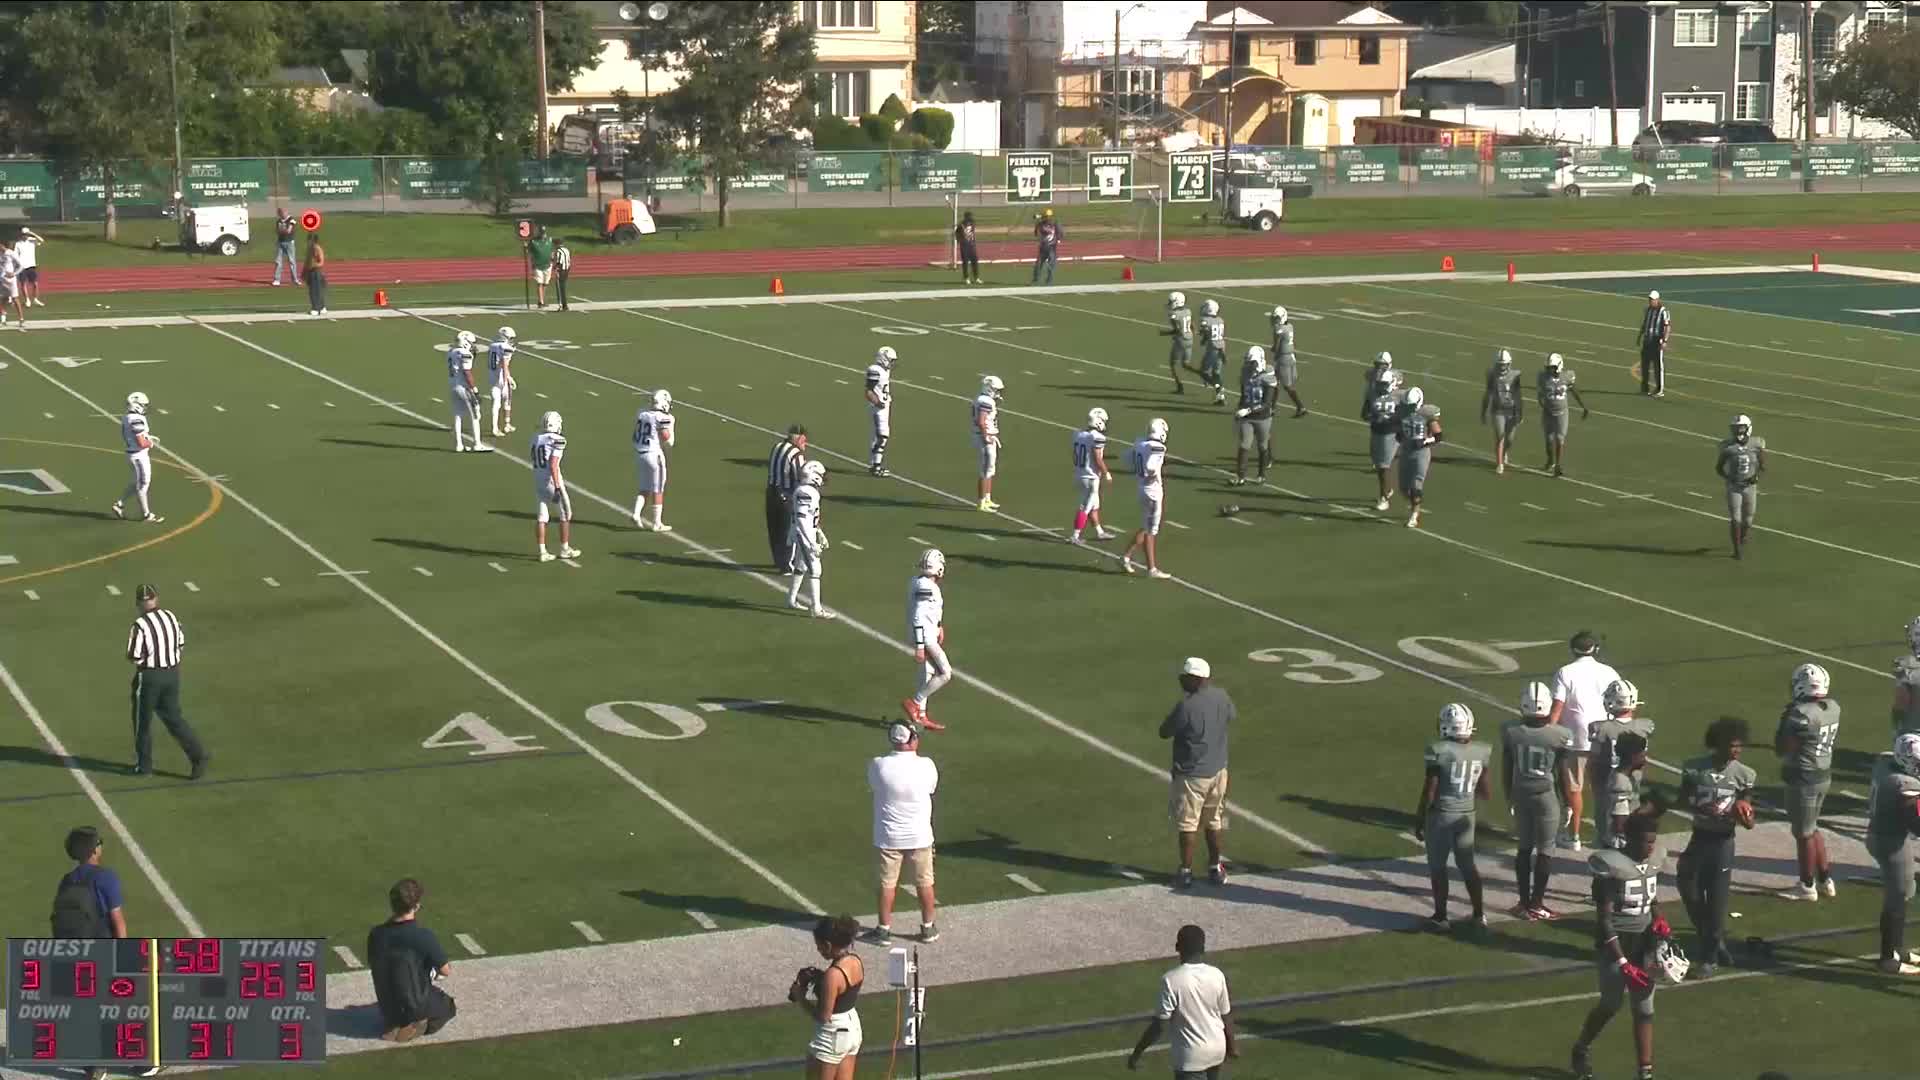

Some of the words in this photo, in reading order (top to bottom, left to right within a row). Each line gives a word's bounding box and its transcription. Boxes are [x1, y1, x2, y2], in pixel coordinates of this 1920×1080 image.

[1021, 177, 1036, 188] 78
[1177, 165, 1205, 190] 73
[422, 699, 708, 756] 40
